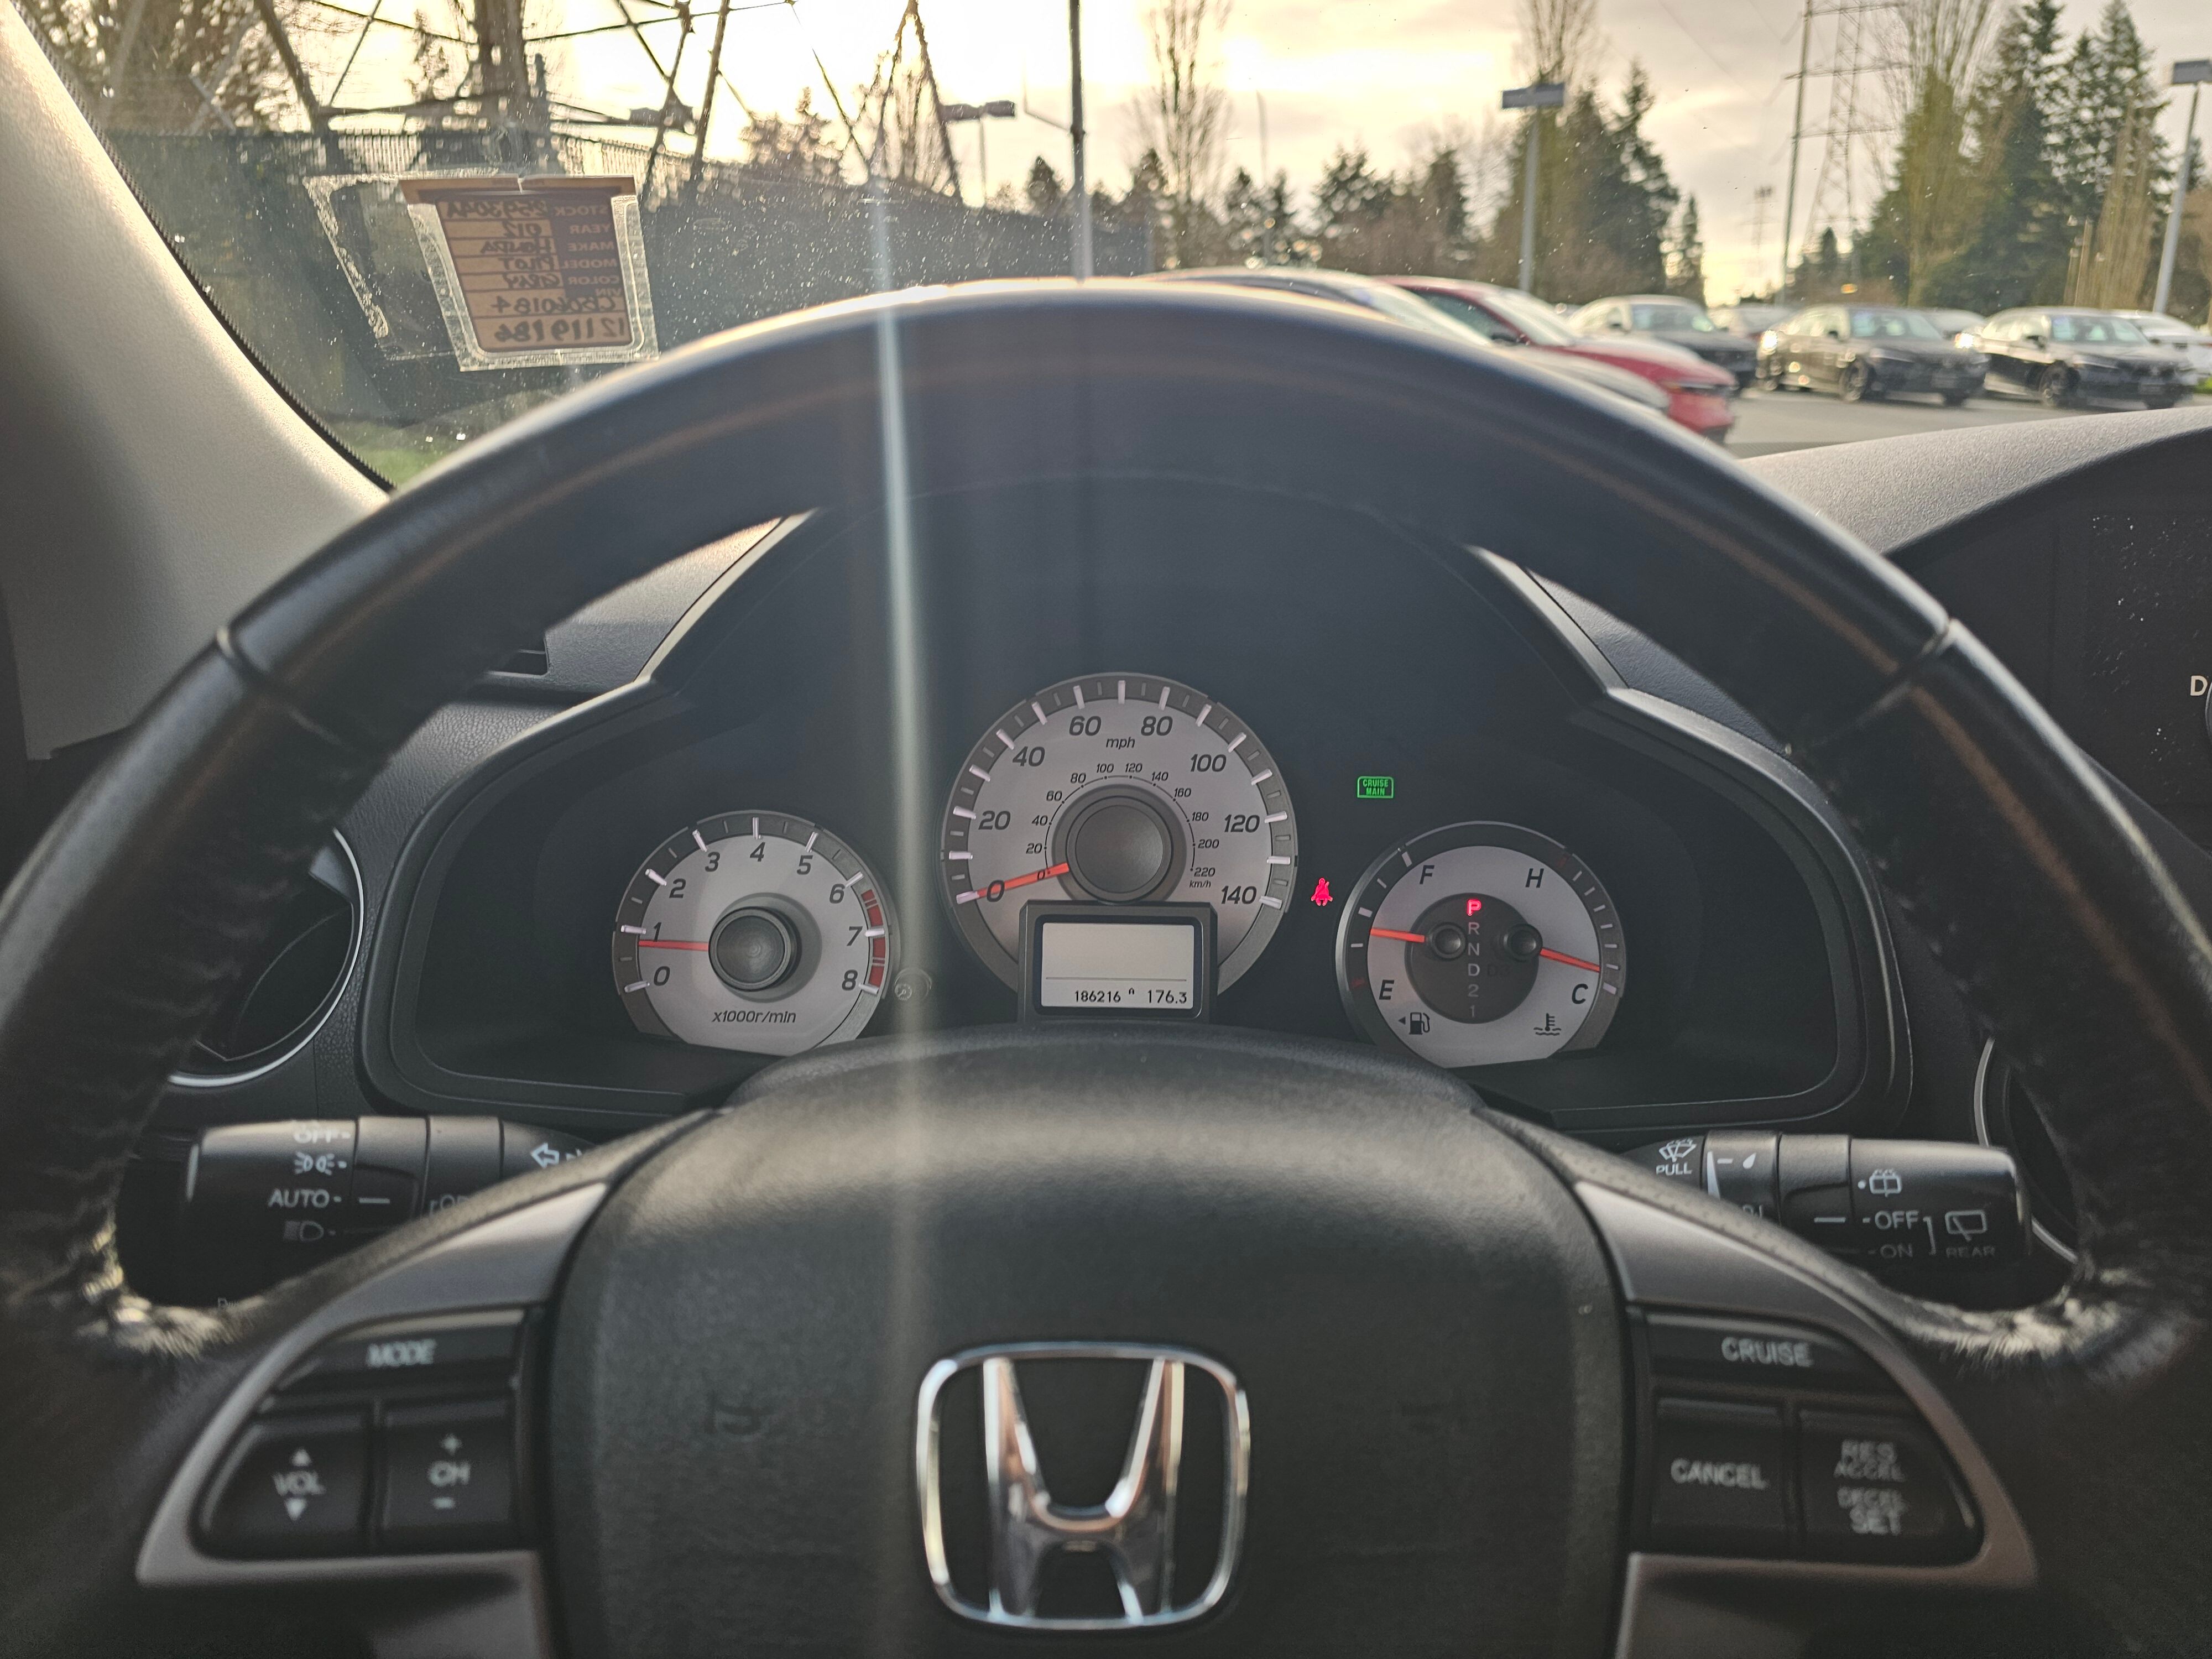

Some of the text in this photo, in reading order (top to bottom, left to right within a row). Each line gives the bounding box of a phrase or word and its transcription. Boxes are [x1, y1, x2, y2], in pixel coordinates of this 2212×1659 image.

[1069, 716, 1102, 736] 60
[1141, 716, 1173, 736] 80
[1105, 737, 1135, 750] mph
[1012, 746, 1045, 767] 40
[1190, 754, 1227, 772] 100
[1097, 763, 1114, 773] 100
[1125, 763, 1142, 773] 120
[1150, 771, 1169, 782] 140
[1070, 773, 1087, 784] 80
[1363, 779, 1389, 787] CRUISE
[1046, 791, 1063, 802] 60
[1173, 788, 1192, 798] 160
[1366, 787, 1385, 796] MAIN
[978, 810, 1011, 830] 20
[1031, 815, 1048, 826] 40
[1192, 812, 1209, 821] 180
[1224, 814, 1260, 833] 120
[749, 842, 766, 862] 4
[1026, 843, 1042, 853] 20
[1198, 839, 1219, 848] 200
[705, 851, 721, 872] 3
[796, 855, 813, 875] 5
[1193, 867, 1215, 877] 220
[1419, 865, 1434, 884] F
[1525, 868, 1545, 888] H
[669, 878, 686, 899] 2
[829, 884, 846, 904] 6
[986, 880, 1005, 902] 0
[1221, 885, 1257, 904] 140
[1467, 899, 1482, 916] P
[653, 922, 662, 942] 1
[847, 926, 863, 946] 7
[1468, 921, 1480, 935] R
[1468, 942, 1480, 956] N
[653, 966, 670, 986] 0
[1468, 963, 1480, 977] D
[842, 969, 858, 991] 8
[1076, 990, 1121, 1003] 186216
[1148, 989, 1187, 1004] 176.3
[1379, 979, 1395, 1000] E
[1468, 984, 1479, 998] 2
[1572, 983, 1588, 1004] C
[712, 1010, 796, 1023] x1000r/min
[1469, 1005, 1475, 1018] 1
[1656, 1164, 1693, 1177] PULL
[269, 1190, 330, 1208] AUTO
[1874, 1210, 1919, 1230] OFF
[1881, 1244, 1913, 1259] ON
[1945, 1245, 1996, 1259] REAR
[367, 1339, 436, 1368] MODE
[1721, 1336, 1813, 1368] CRUISE
[1670, 1458, 1768, 1489] CANCEL
[273, 1470, 326, 1496] VOL
